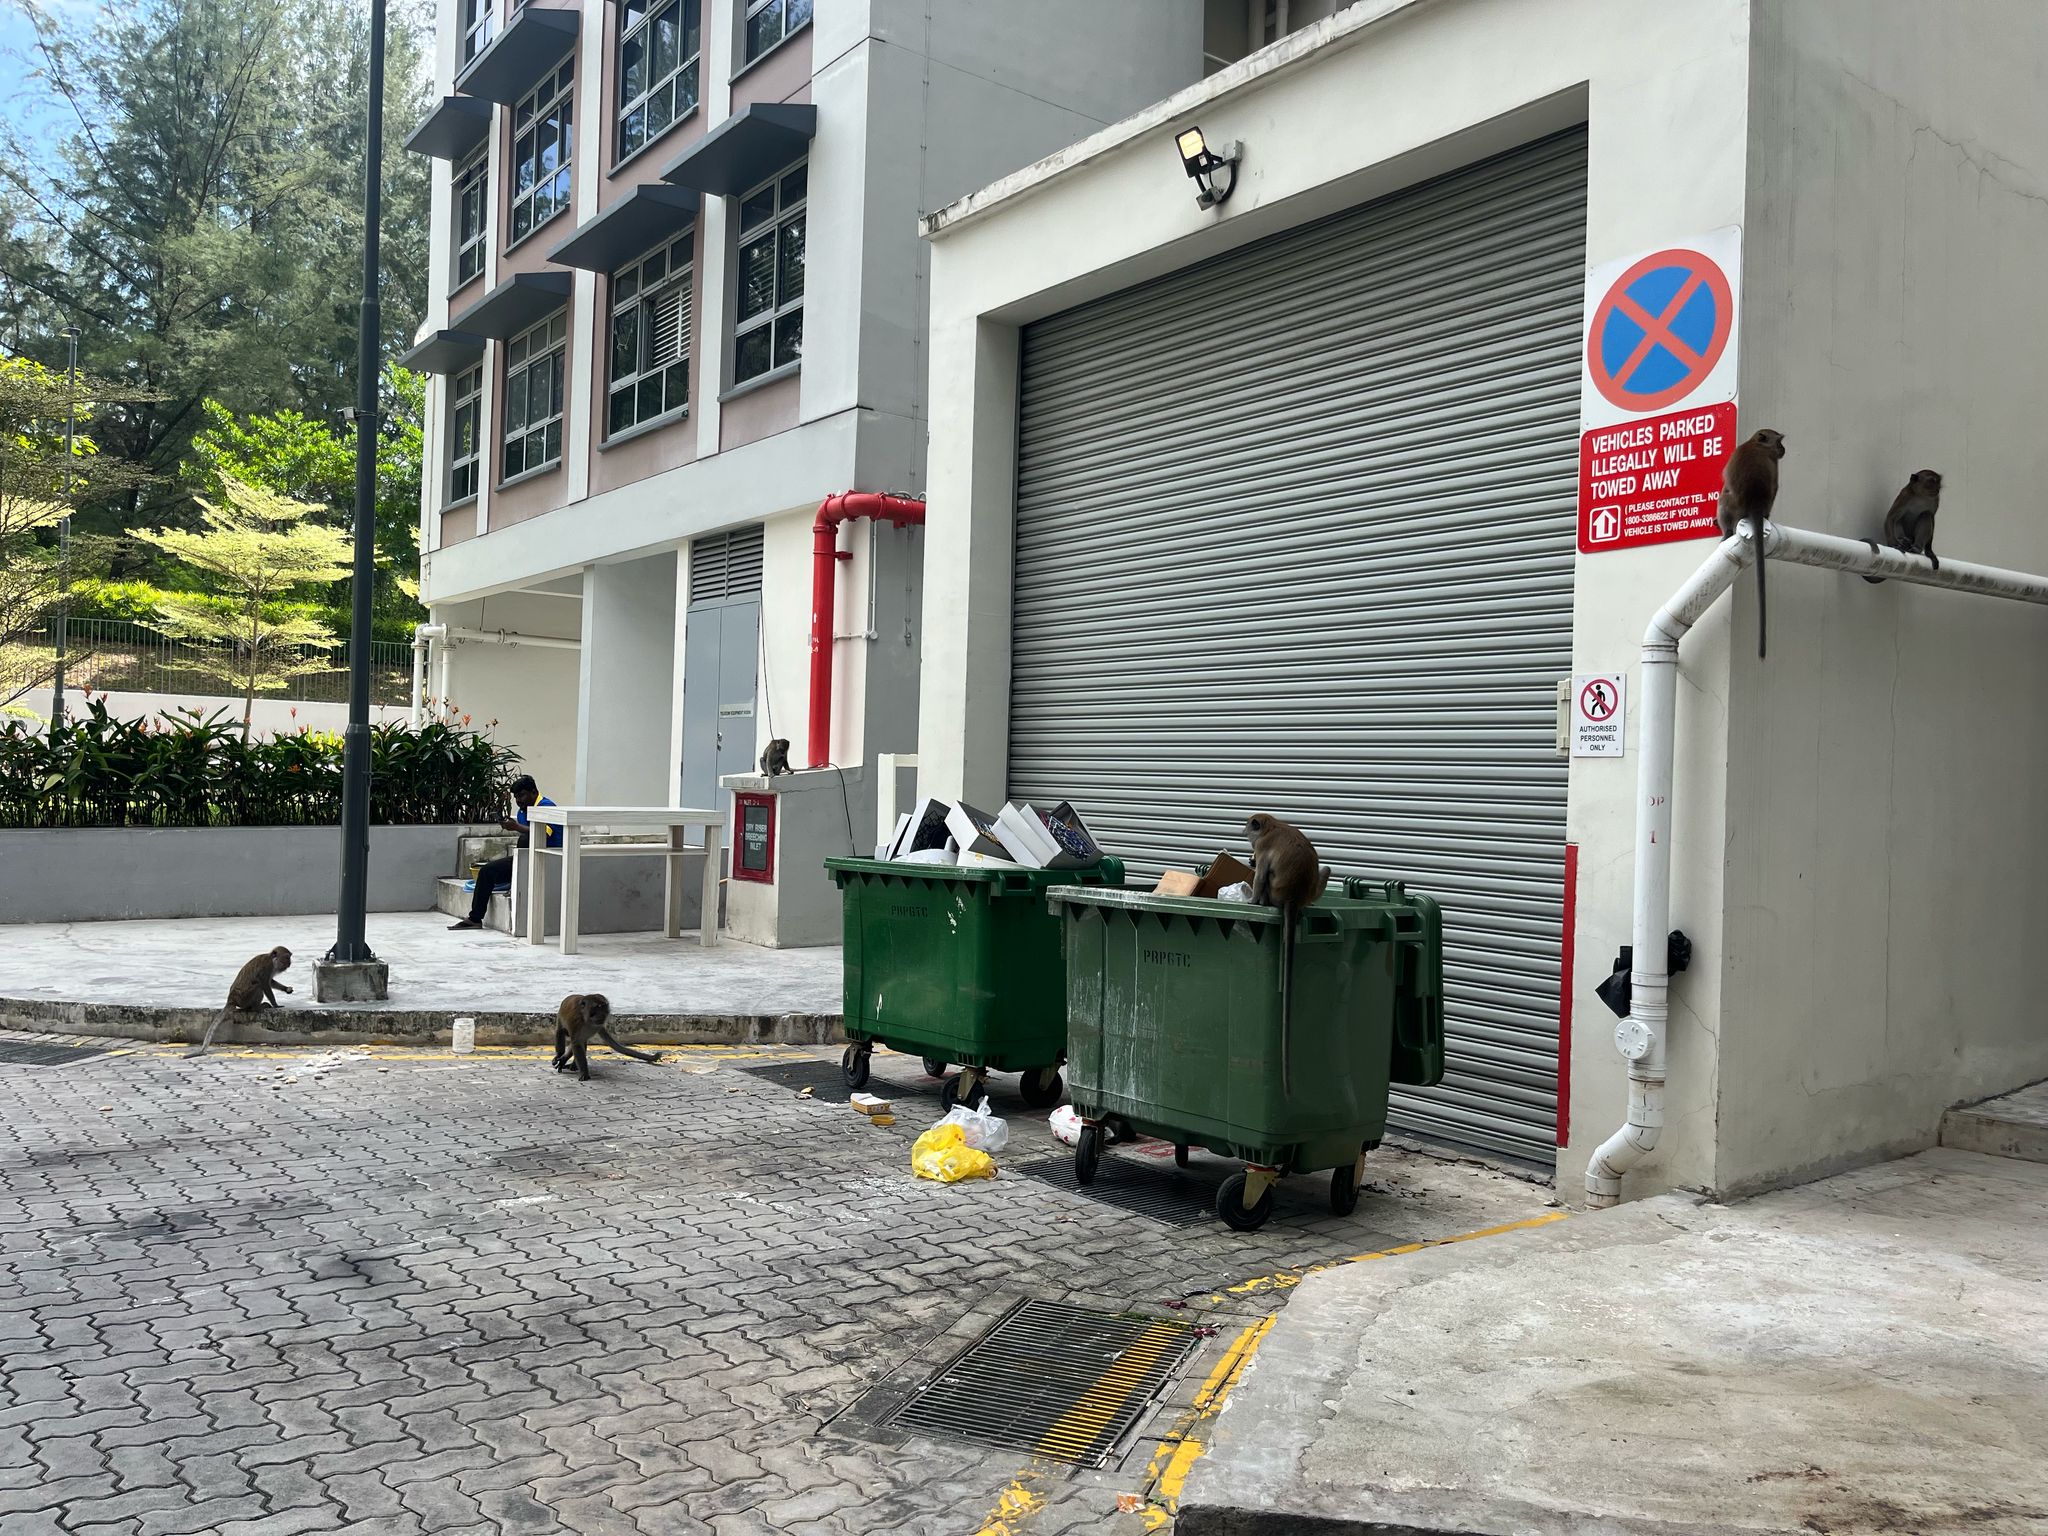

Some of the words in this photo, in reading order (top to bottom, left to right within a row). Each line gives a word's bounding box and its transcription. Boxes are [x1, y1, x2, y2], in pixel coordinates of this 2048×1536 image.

[1592, 426, 1653, 454] VEHICLES
[1659, 414, 1715, 442] PARKED
[1591, 448, 1658, 477] ILLEGALLY
[1664, 442, 1696, 464] WILL
[1703, 437, 1722, 458] BE
[1591, 476, 1636, 500] TOWED
[1642, 468, 1680, 492] AWAY
[1656, 496, 1690, 509] CONTACT
[1691, 494, 1706, 504] TEL.
[1669, 510, 1677, 519] IF
[1678, 507, 1699, 517] YOUR
[1624, 525, 1653, 537] VEHICLE
[1654, 524, 1661, 533] IS
[1662, 521, 1689, 531] TOWED
[1690, 517, 1713, 529] AWAY)
[1579, 725, 1618, 733] AUTHORISED
[1589, 744, 1606, 752] ONLY
